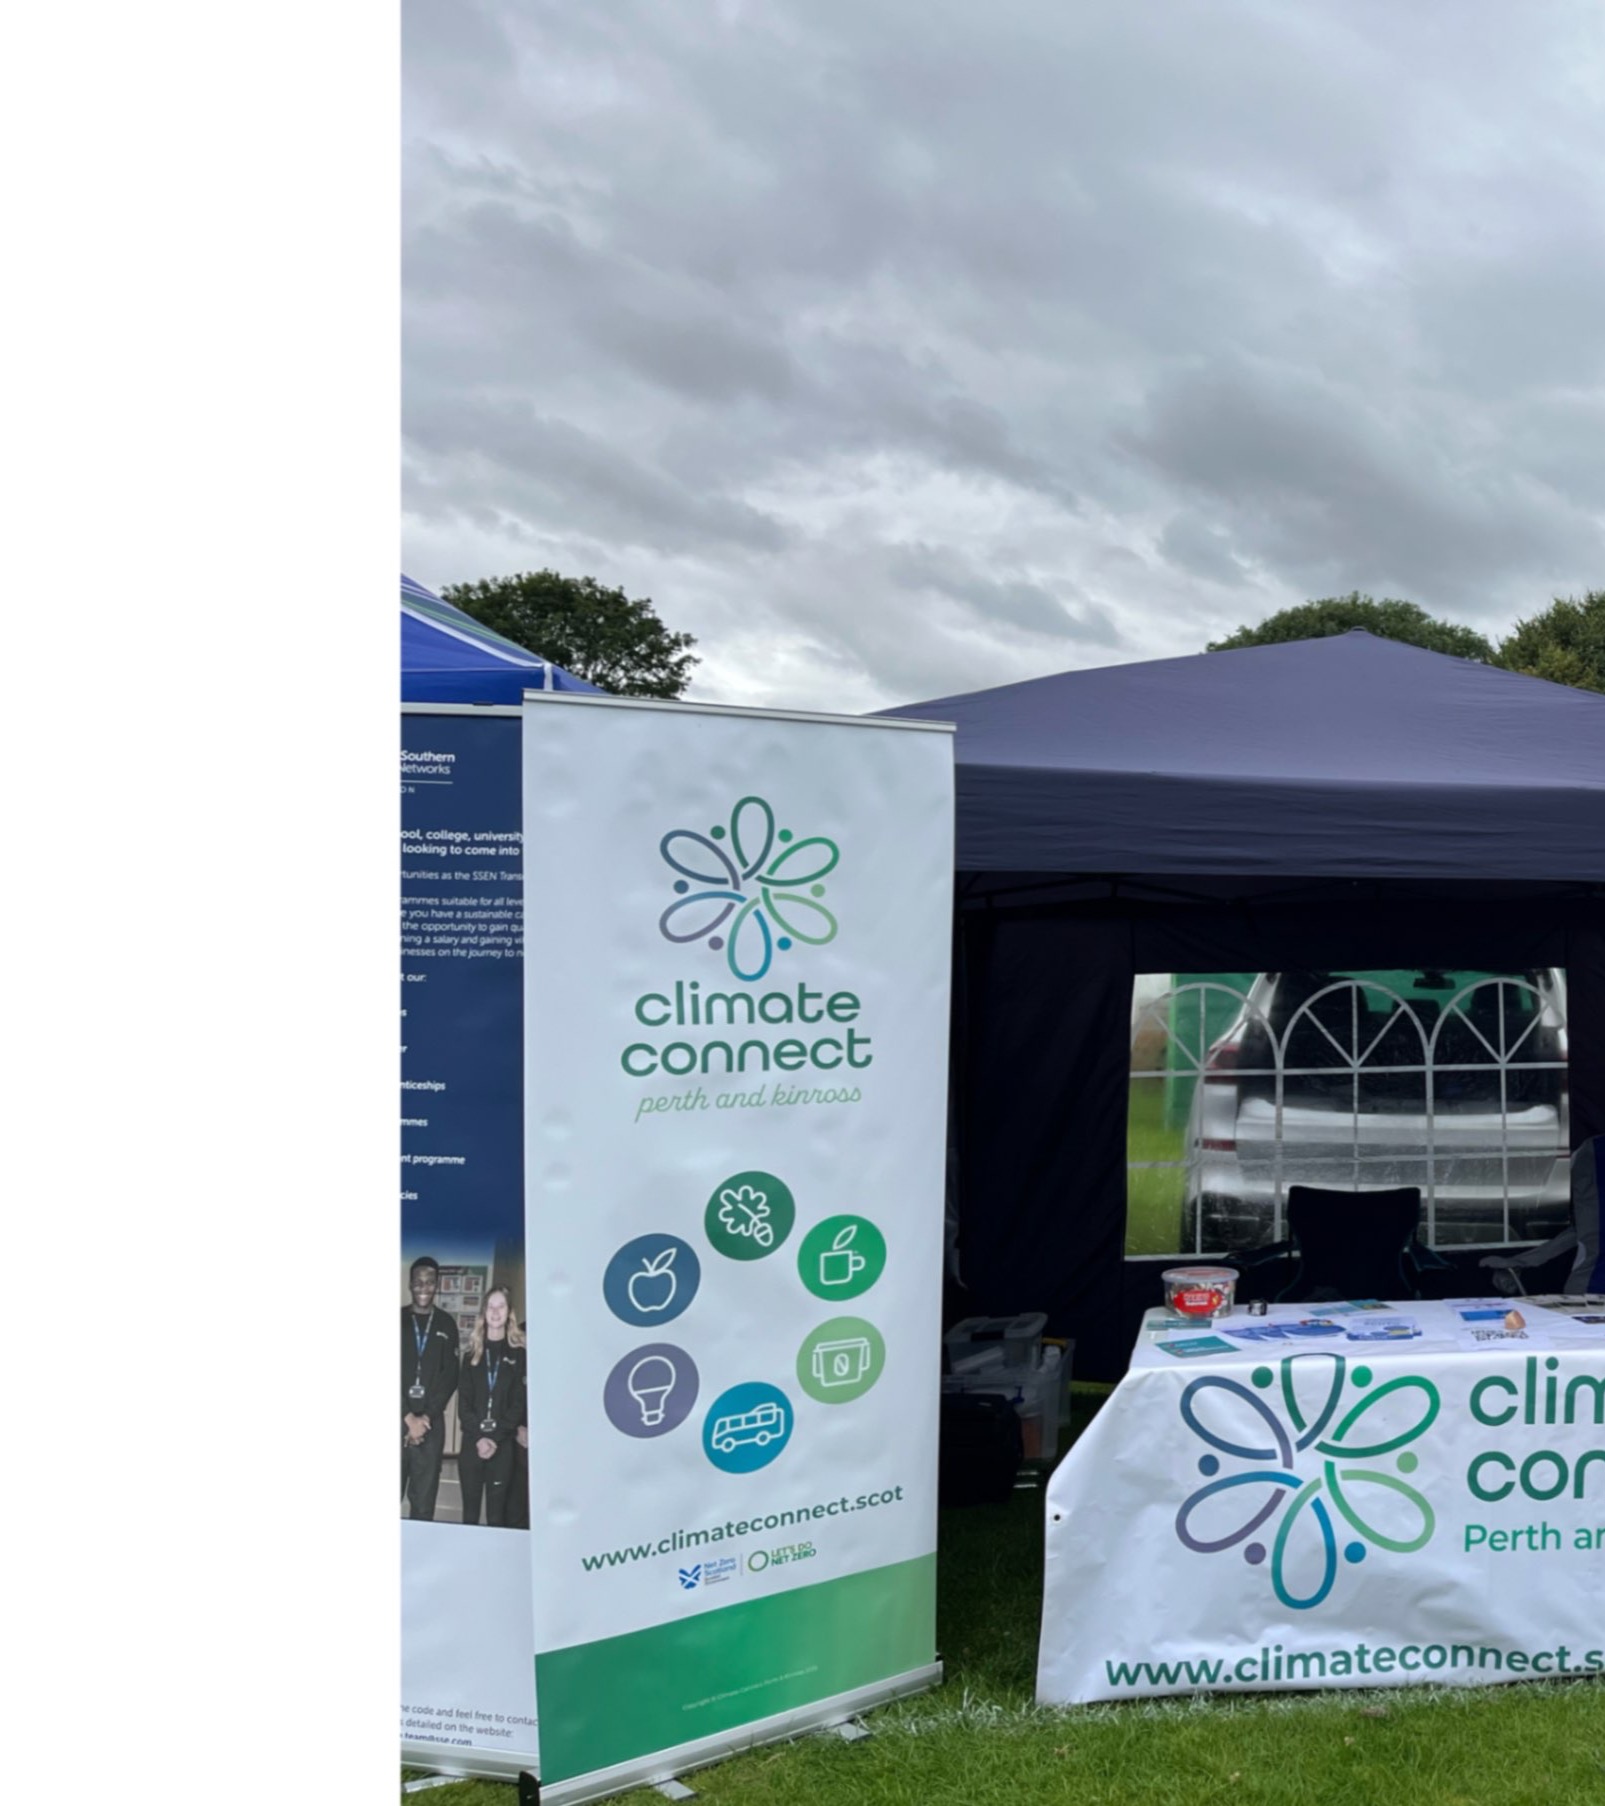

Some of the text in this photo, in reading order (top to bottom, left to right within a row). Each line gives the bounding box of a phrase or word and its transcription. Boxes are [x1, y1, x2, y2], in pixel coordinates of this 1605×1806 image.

[400, 750, 455, 763] Southern
[426, 830, 471, 843] college,
[403, 843, 520, 857] looking to come into
[441, 872, 452, 880] as
[454, 871, 470, 880] the
[441, 897, 478, 906] suitable
[480, 897, 492, 906] for
[493, 897, 504, 906] all
[409, 911, 429, 920] you
[431, 909, 454, 918] have
[464, 909, 513, 919] sustainable
[402, 922, 419, 930] the
[421, 922, 476, 934] opportunity
[478, 923, 487, 931] to
[489, 923, 508, 934] gain
[433, 935, 460, 946] salary
[461, 935, 478, 944] and
[480, 936, 513, 947] gaining
[438, 949, 450, 957] on
[452, 948, 468, 957] the
[468, 948, 502, 959] journey
[504, 949, 515, 957] to
[635, 980, 861, 1027] climate
[621, 1028, 873, 1077] connect
[634, 1083, 862, 1123] perth and kinross
[412, 1155, 465, 1166] programme
[581, 1485, 904, 1572] www.climateconnect.scot
[1464, 1521, 1562, 1553] Perth
[771, 1549, 817, 1567] NET ZERO
[412, 1704, 434, 1715] code
[436, 1708, 453, 1718] and
[455, 1708, 472, 1719] feel
[474, 1711, 493, 1721] free
[495, 1713, 505, 1722] to
[406, 1719, 442, 1730] detailed
[444, 1723, 457, 1732] on
[460, 1724, 474, 1733] the
